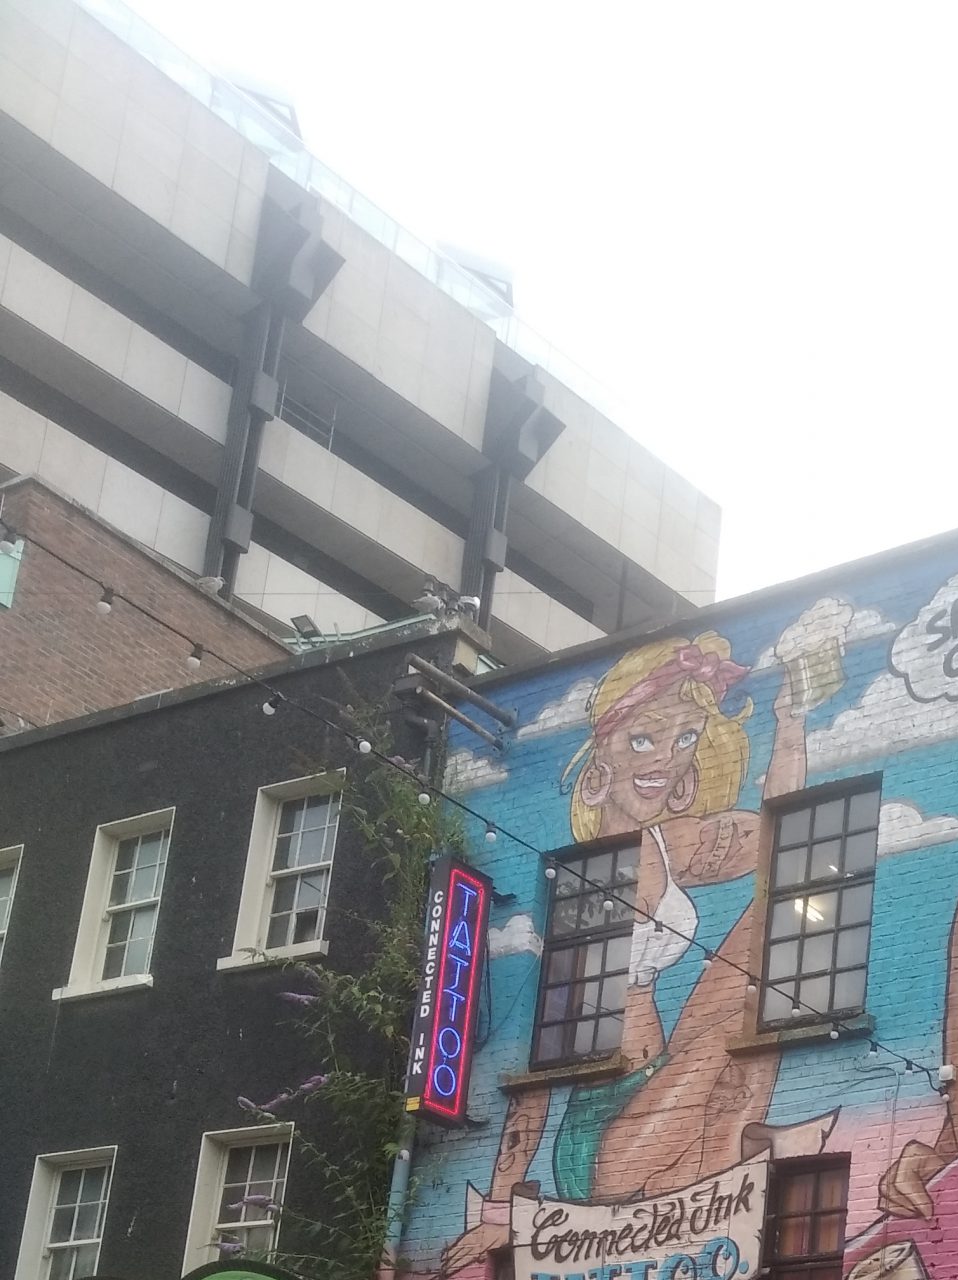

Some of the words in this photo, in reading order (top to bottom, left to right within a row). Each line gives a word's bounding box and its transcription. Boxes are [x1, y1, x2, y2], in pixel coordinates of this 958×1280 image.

[420, 890, 443, 1017] CONNECTED
[434, 883, 477, 1096] TATTOO
[412, 1033, 424, 1074] INK
[690, 1173, 754, 1235] Ink
